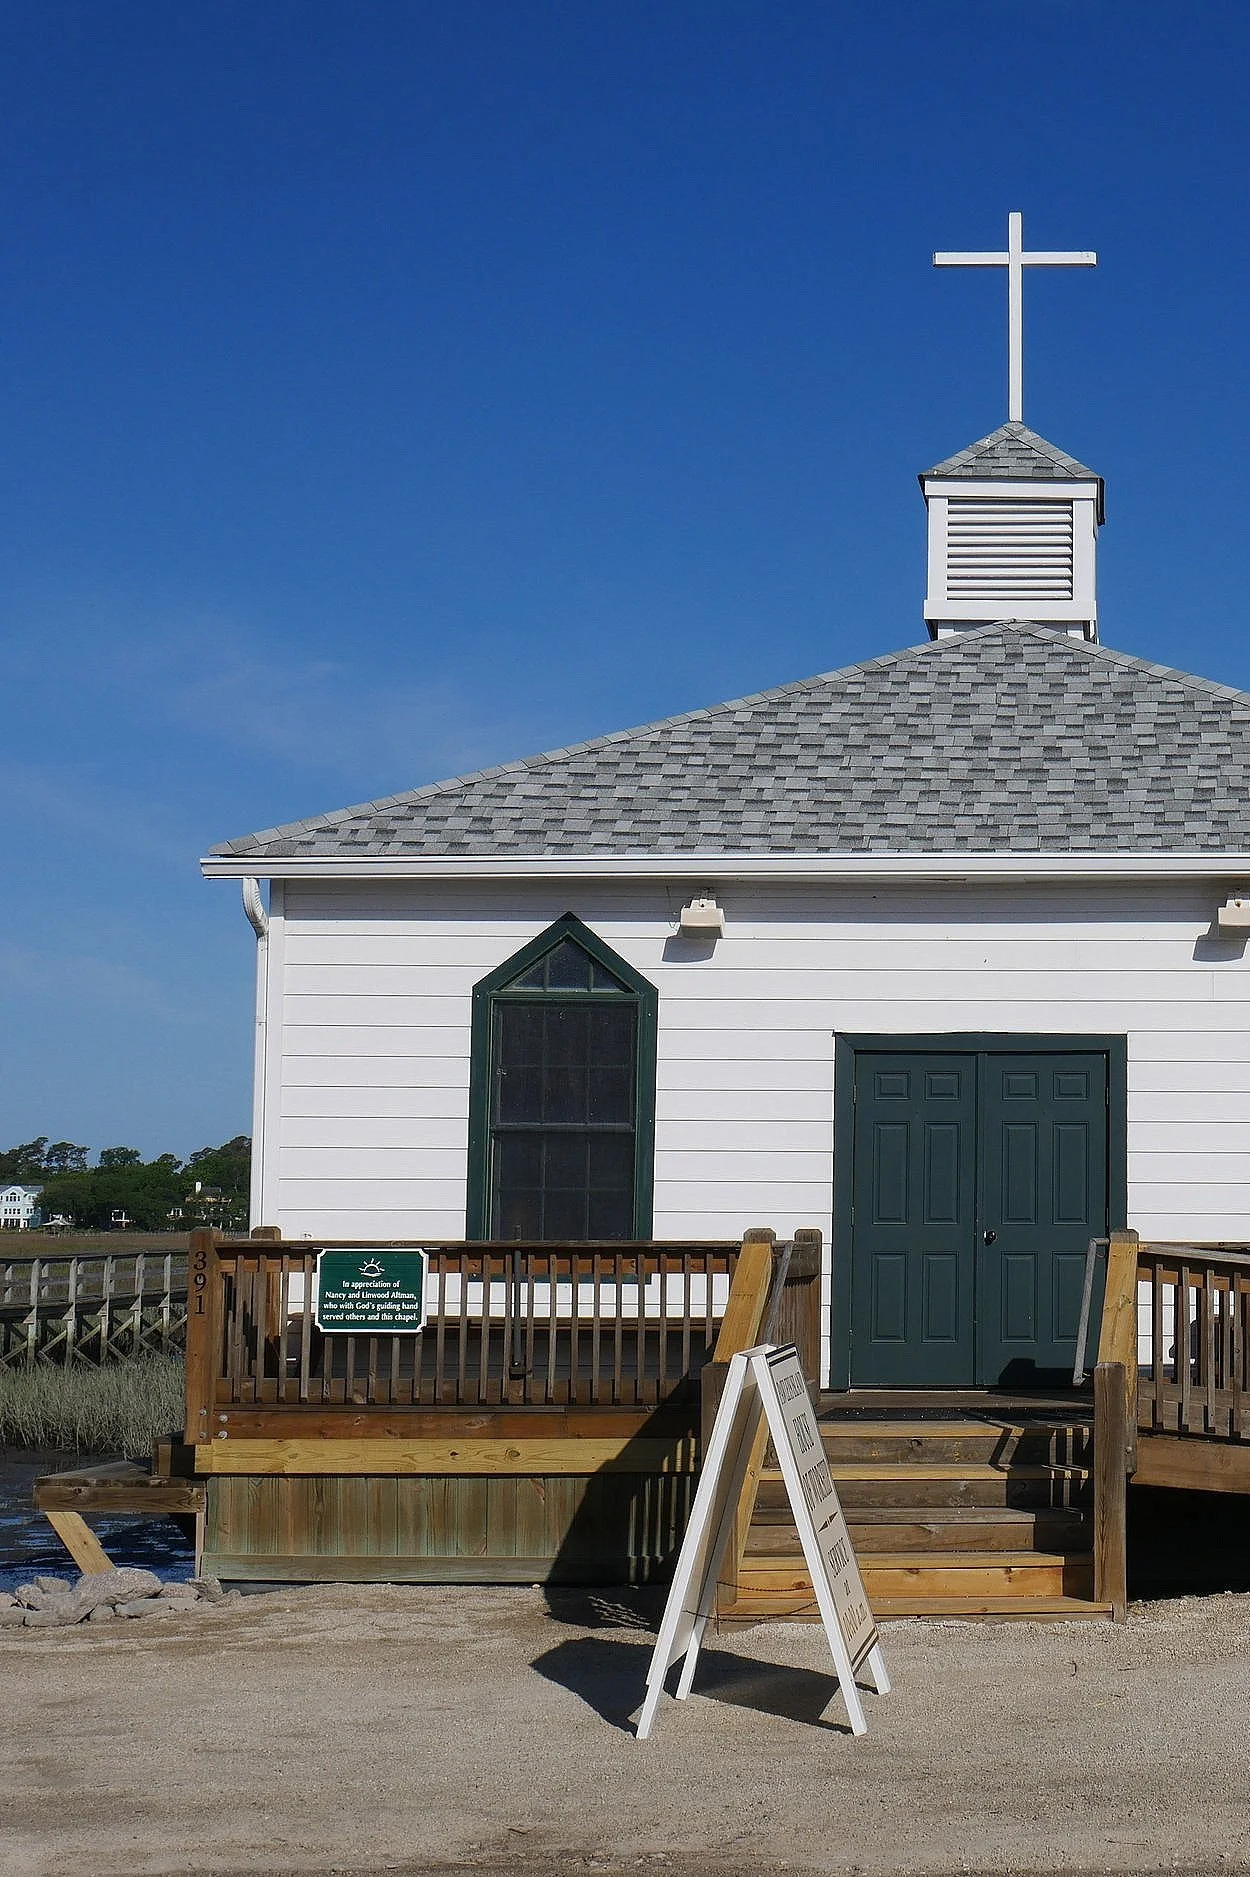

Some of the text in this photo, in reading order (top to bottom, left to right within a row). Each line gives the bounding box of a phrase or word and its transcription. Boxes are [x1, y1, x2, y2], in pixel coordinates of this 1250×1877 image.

[193, 1250, 207, 1315] 391
[342, 1280, 401, 1290] In appreciation of
[325, 1291, 417, 1301] Nancy and Linwood Altman,
[323, 1301, 419, 1312] who with God's guiding hand
[322, 1312, 418, 1323] served others and this chapel.
